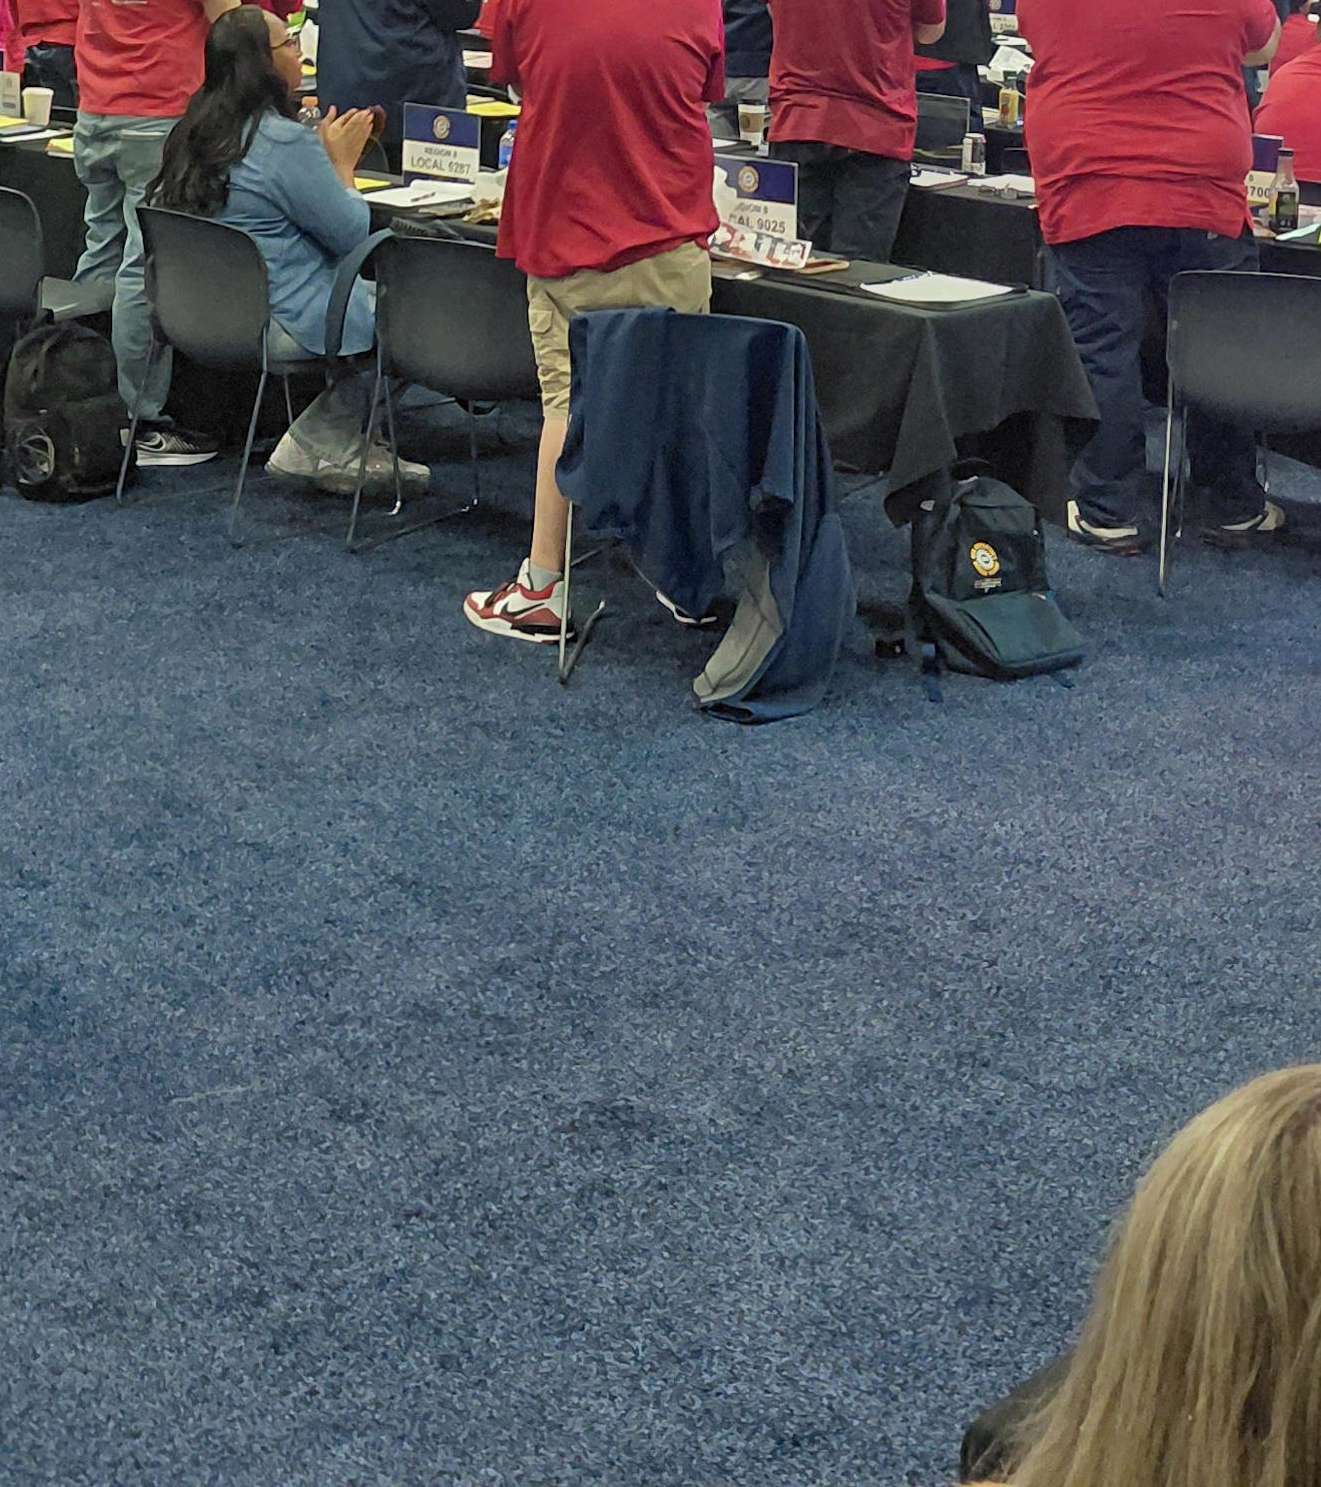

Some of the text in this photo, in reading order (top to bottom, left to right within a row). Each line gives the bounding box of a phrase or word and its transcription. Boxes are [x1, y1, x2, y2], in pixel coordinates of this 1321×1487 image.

[411, 156, 445, 171] LOCAL
[1246, 186, 1270, 198] 700
[729, 213, 754, 229] CAL
